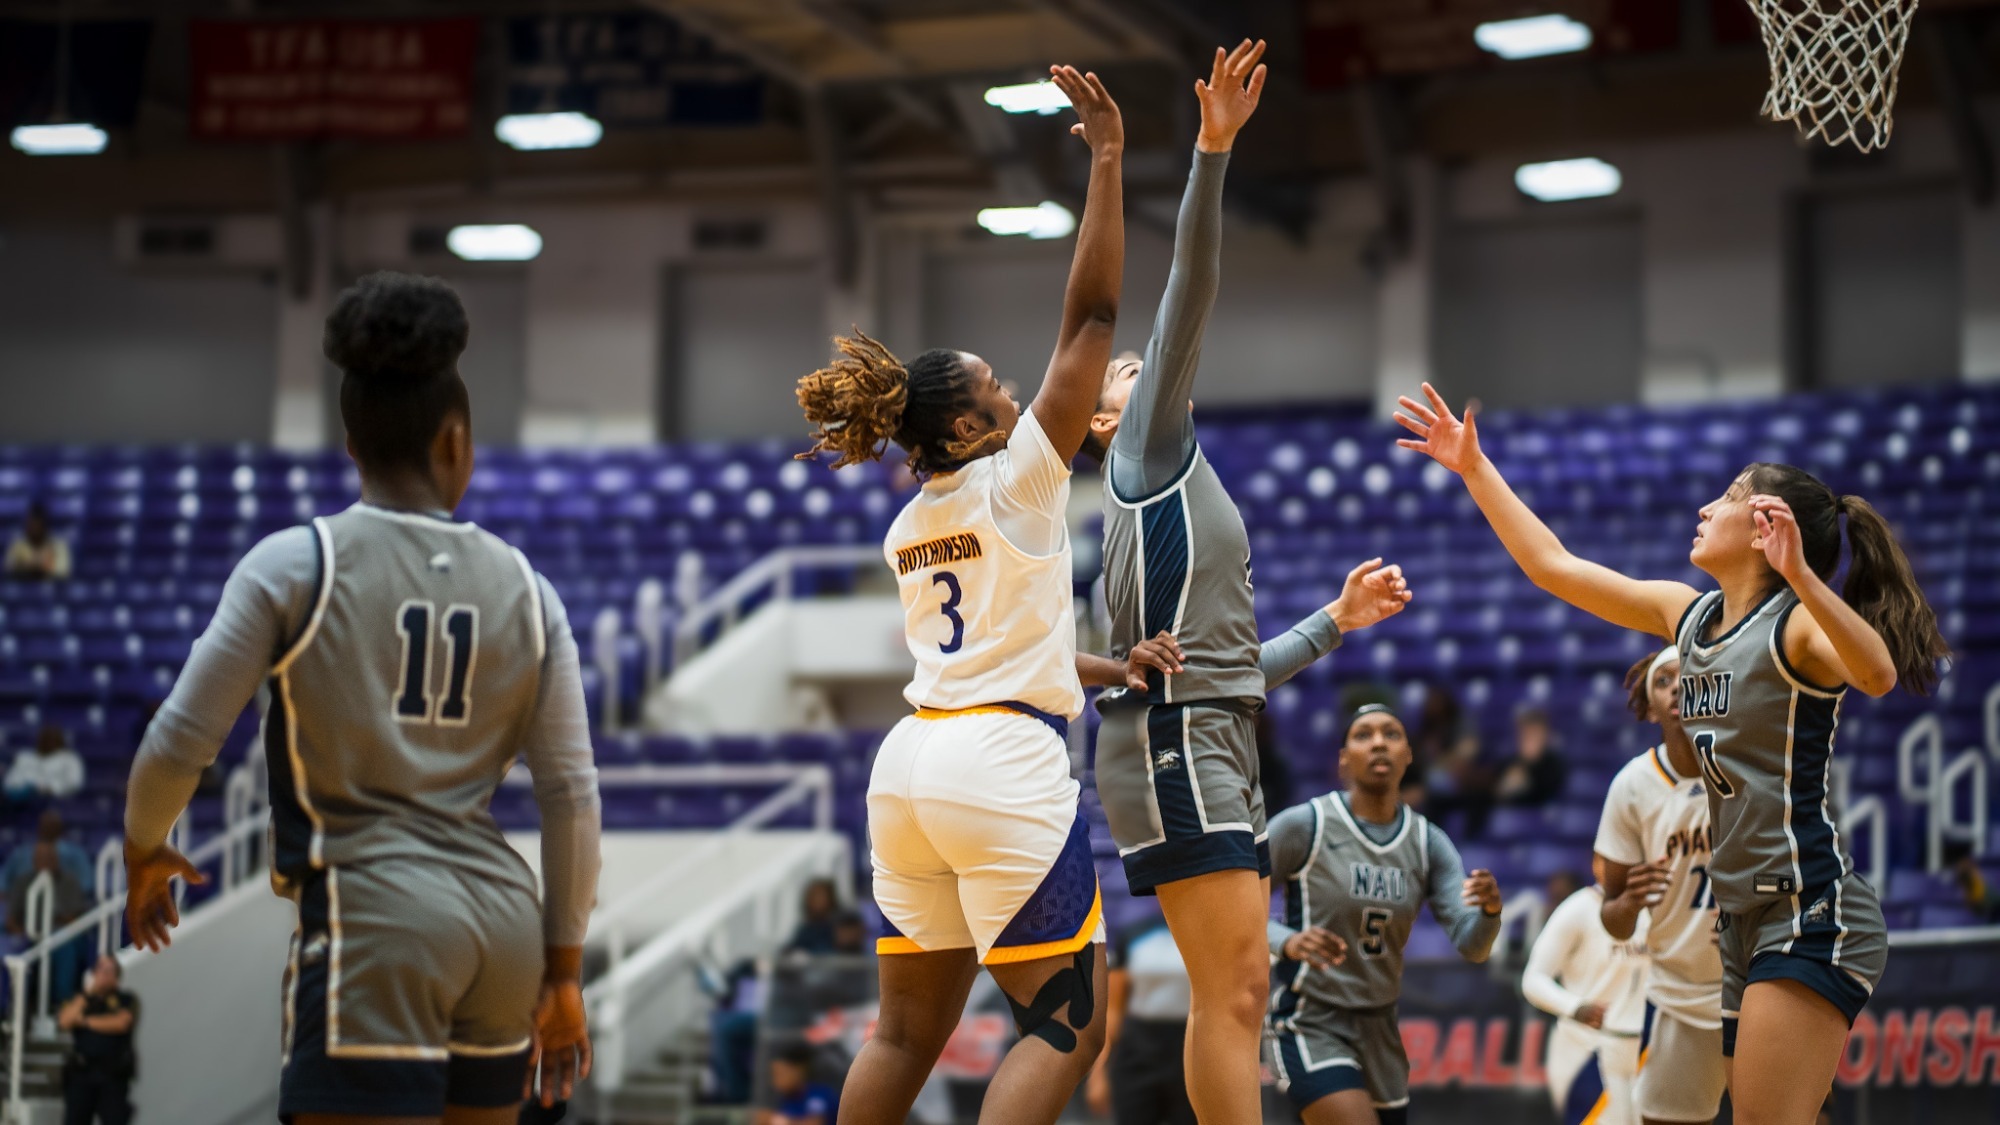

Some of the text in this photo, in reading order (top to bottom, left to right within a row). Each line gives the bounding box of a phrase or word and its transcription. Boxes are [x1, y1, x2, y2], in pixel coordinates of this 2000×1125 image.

[896, 532, 983, 576] HUTCHINSON
[932, 571, 964, 654] 3
[391, 598, 480, 727] 11
[1681, 671, 1733, 720] NAU
[1350, 862, 1407, 904] NAU
[1358, 907, 1393, 960] 5
